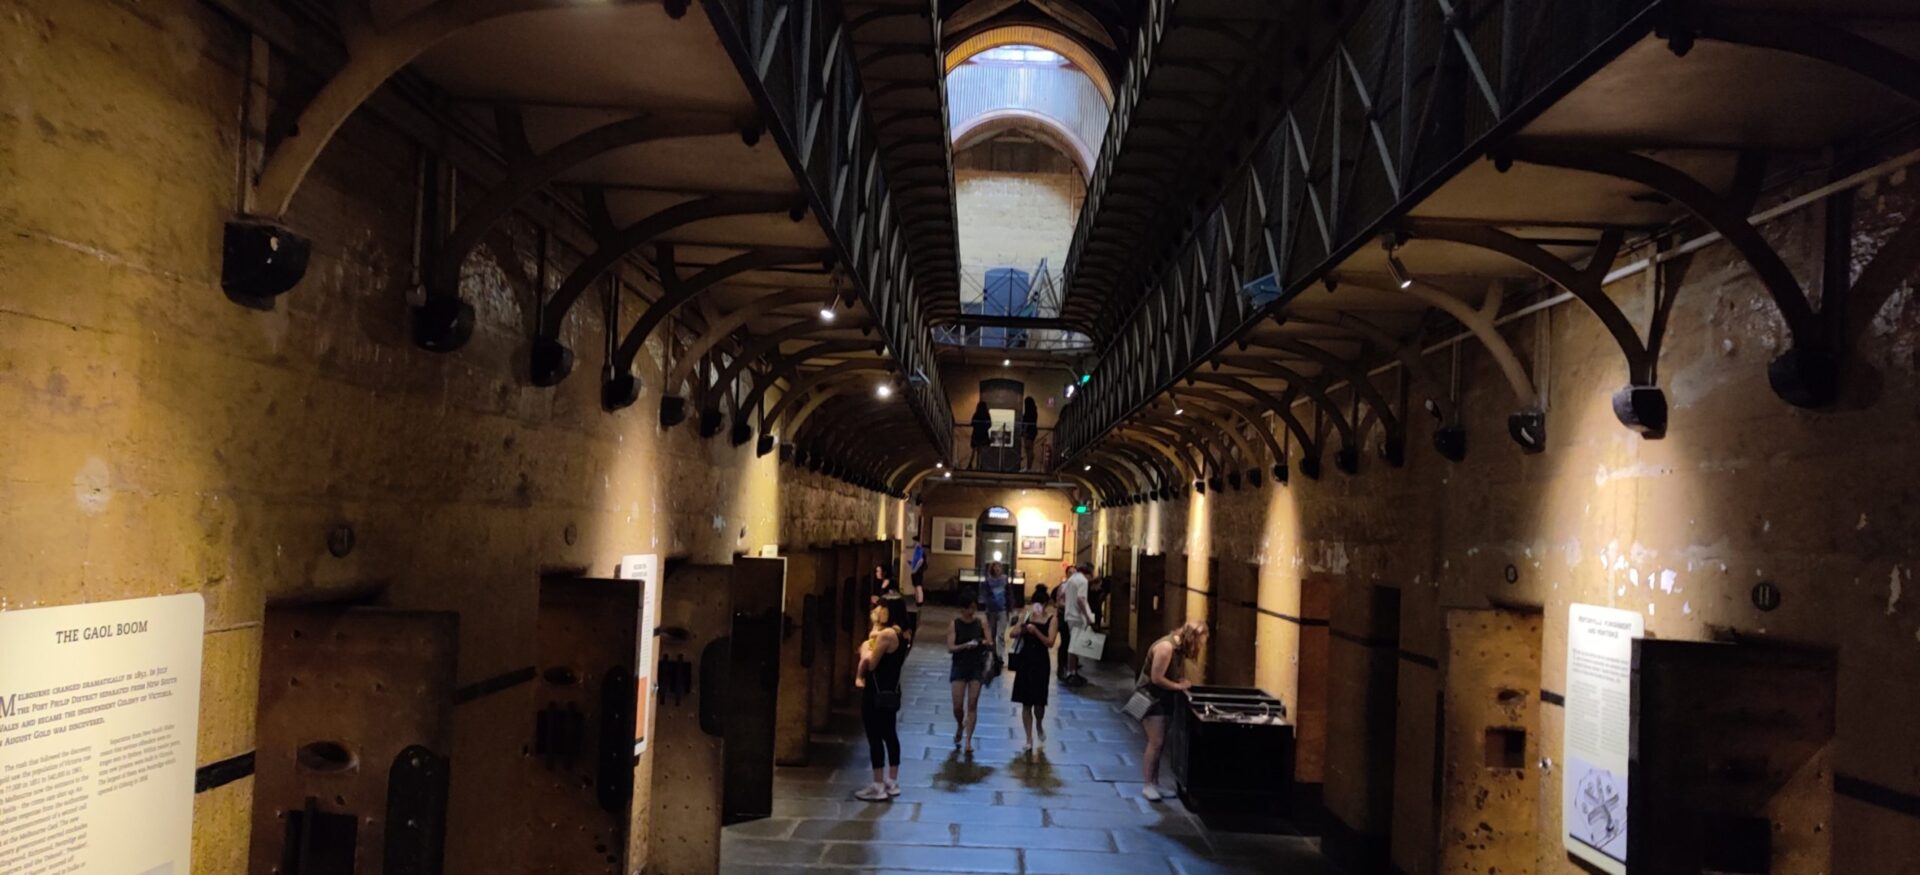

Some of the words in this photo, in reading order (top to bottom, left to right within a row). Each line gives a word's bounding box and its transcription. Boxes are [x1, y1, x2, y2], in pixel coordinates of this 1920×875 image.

[56, 629, 79, 644] THE
[83, 625, 113, 640] GAOL
[116, 621, 148, 636] BOOM
[52, 683, 81, 695] CHANGED
[82, 674, 125, 689] DRAMATICALLY
[17, 706, 29, 715] THE
[32, 703, 48, 712] PORT
[71, 693, 97, 704] DISTRICT
[99, 687, 129, 698] SEPARATED
[130, 683, 145, 691] FROM
[21, 719, 36, 728] AND
[38, 713, 62, 724] BECAME
[64, 710, 76, 719] THE
[77, 702, 116, 716] INDEPENDENT
[117, 697, 139, 707] COLONY
[4, 733, 32, 746] AUGUST
[33, 729, 51, 739] GOLD
[53, 725, 67, 735] WAS
